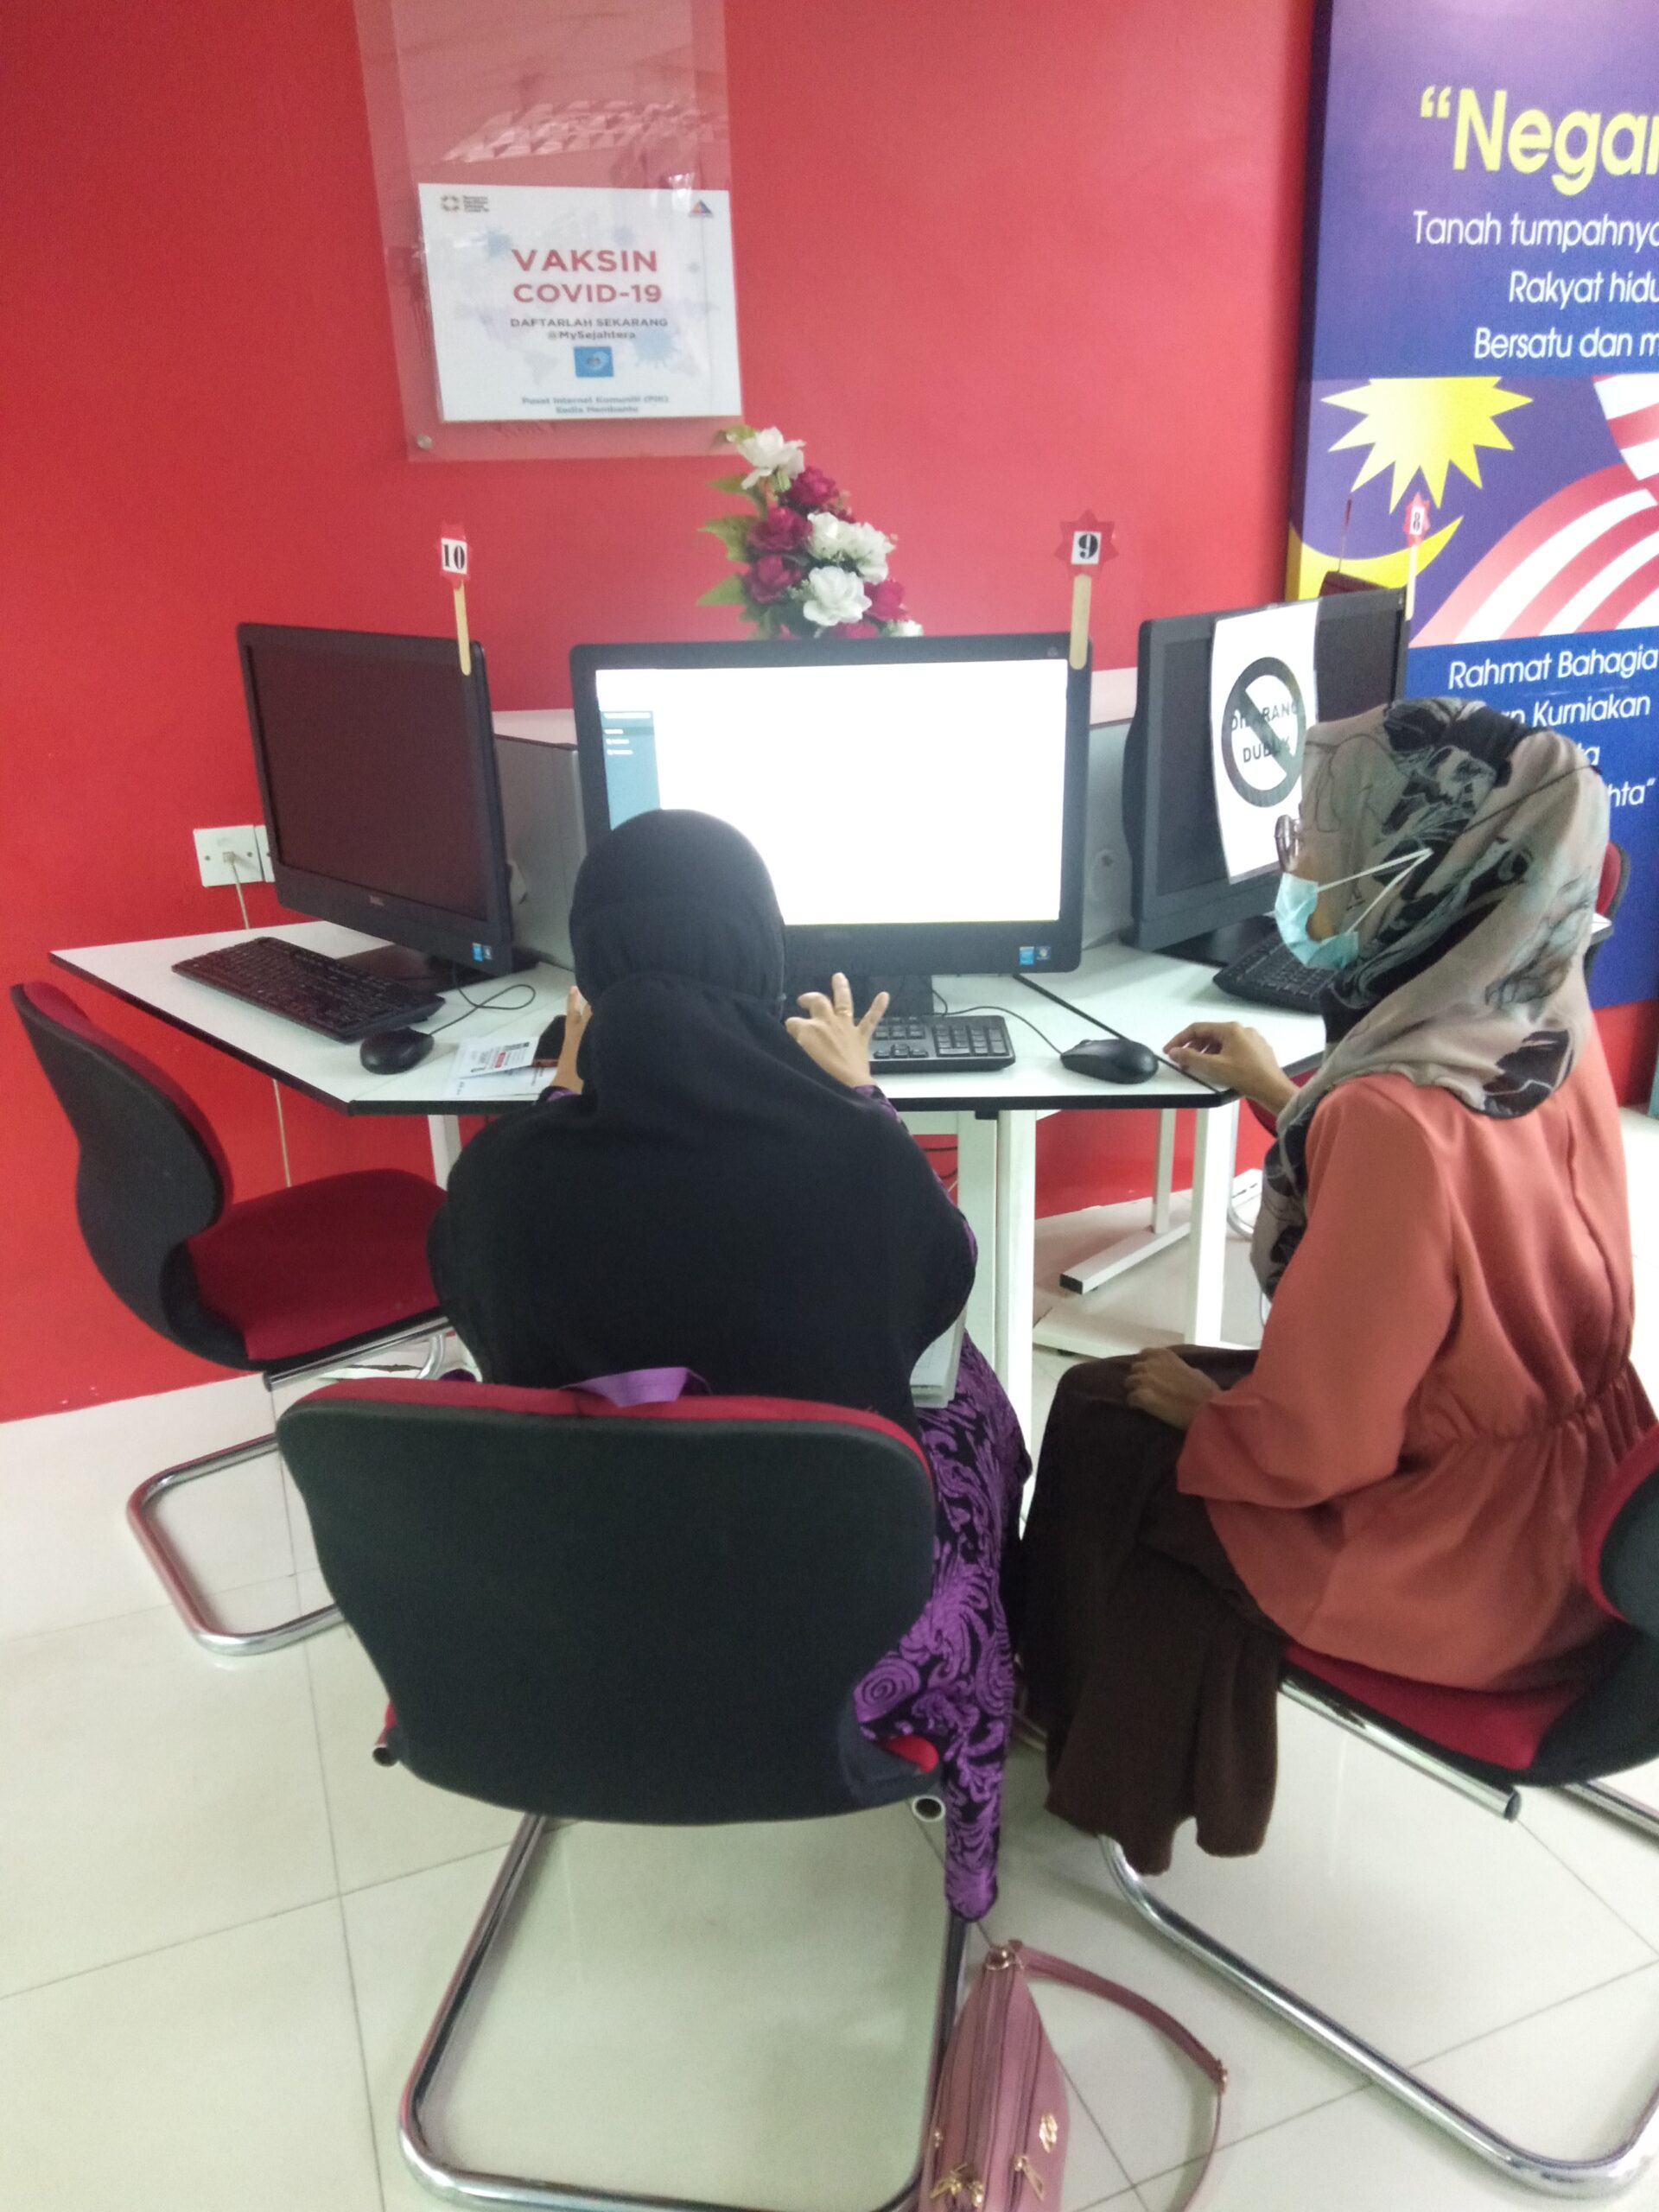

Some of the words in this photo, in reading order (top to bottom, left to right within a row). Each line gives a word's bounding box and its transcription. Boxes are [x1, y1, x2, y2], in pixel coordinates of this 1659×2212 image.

[1413, 209, 1503, 246] Tanah
[511, 248, 658, 273] VAKSIN
[512, 282, 663, 304] COVID-19
[1508, 269, 1605, 310] Rakyat
[510, 317, 593, 327] DAFTARLAH
[595, 317, 669, 327] SEKARANG
[547, 330, 637, 341] @MySejahtera
[1474, 327, 1573, 359] Bersatu
[1579, 326, 1633, 359] dan
[1412, 511, 1421, 532] 8
[442, 543, 467, 570] 10
[1077, 532, 1099, 560] 9
[1447, 651, 1553, 690] Rahmat
[1557, 643, 1659, 679] Bahagia
[1531, 693, 1652, 728] Kurniakan
